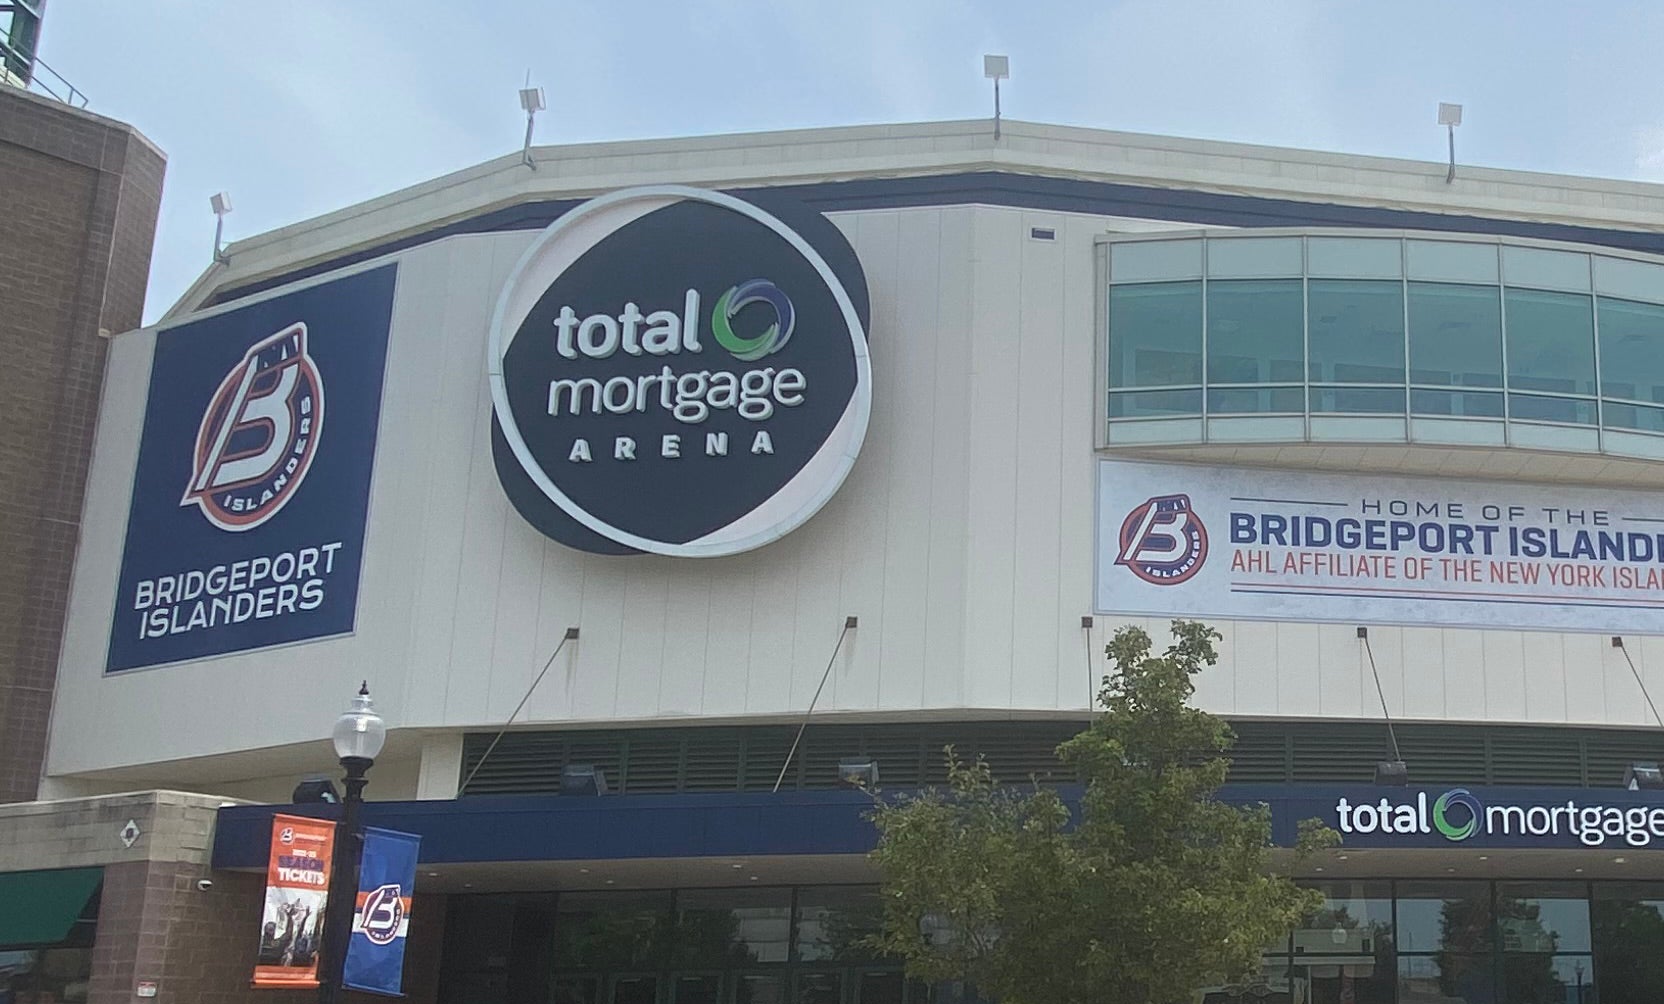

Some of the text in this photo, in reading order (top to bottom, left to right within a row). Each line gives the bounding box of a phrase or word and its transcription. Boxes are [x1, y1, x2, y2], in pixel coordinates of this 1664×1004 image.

[553, 288, 700, 360] total
[547, 366, 806, 423] mortgage
[224, 396, 311, 511] ISLANDERS
[568, 430, 775, 462] ARENA
[1230, 512, 1500, 556] BRIDGEPORT
[1361, 498, 1611, 527] HOME OF THE
[134, 541, 342, 611] BRIDGEPORT
[1231, 549, 1277, 575] AHL
[1284, 551, 1398, 580] AFFILIATE
[1403, 556, 1434, 581] OF
[1439, 558, 1483, 583] THE
[1489, 560, 1542, 586] NEW
[1548, 563, 1607, 588] YORK
[139, 577, 325, 641] ISLANDERS
[1335, 792, 1431, 835] total
[277, 866, 325, 885] TICKETS
